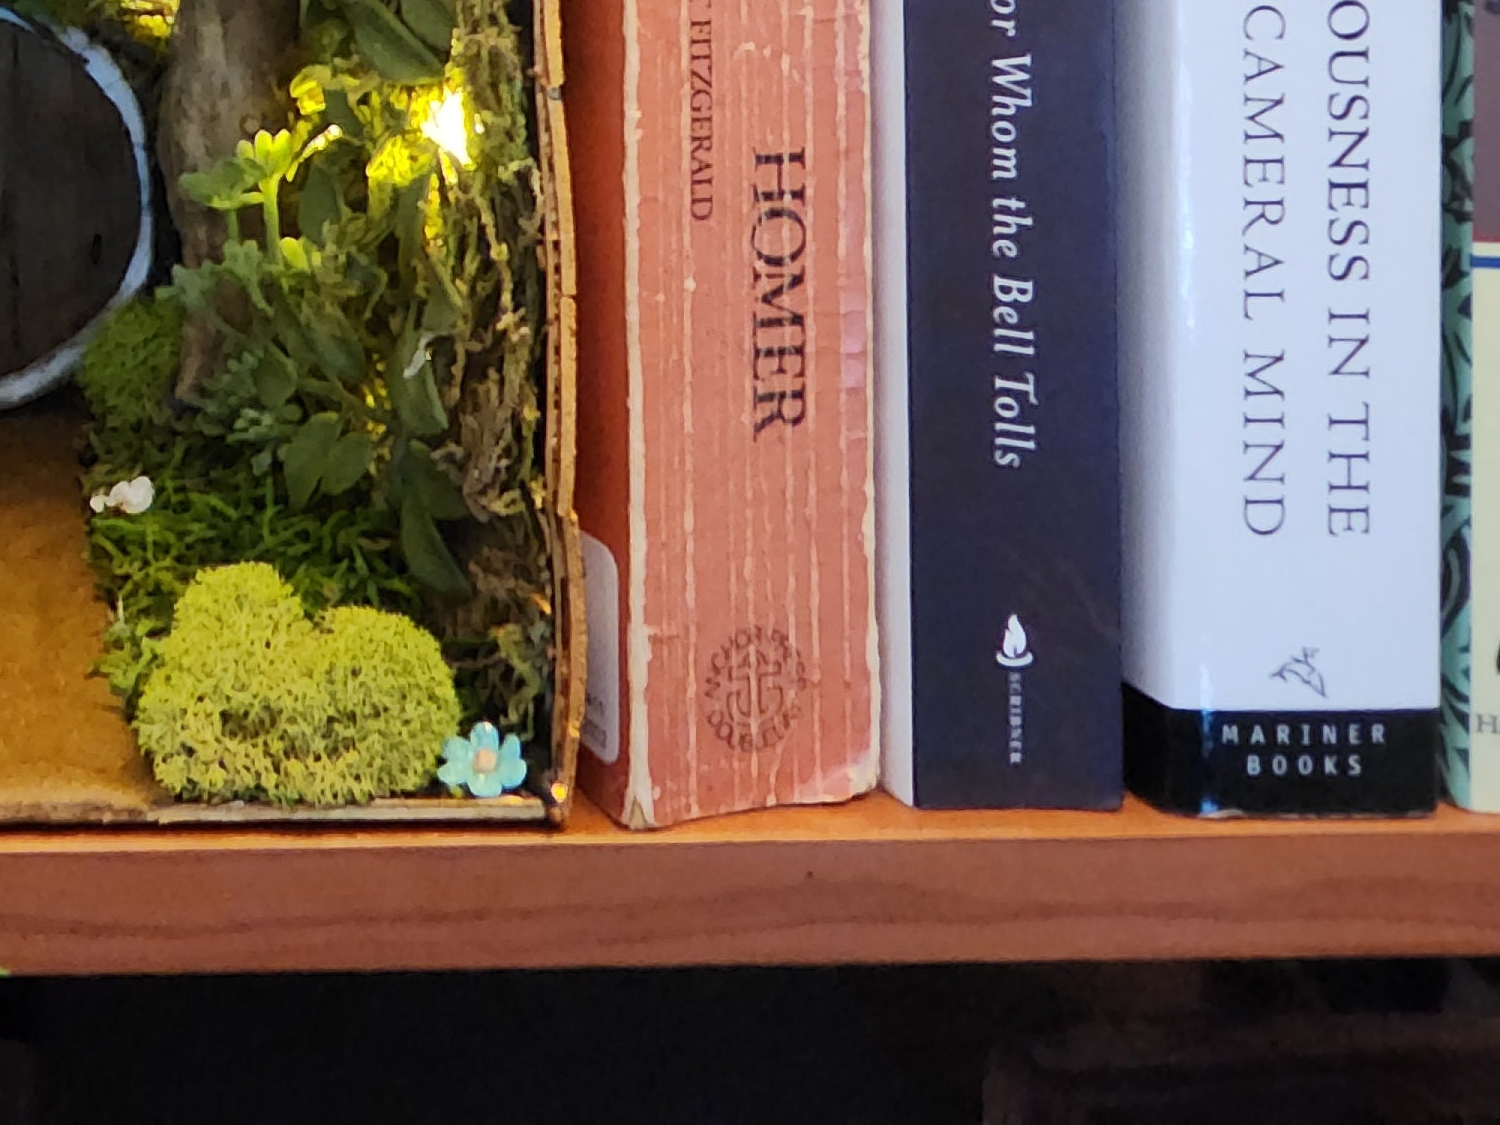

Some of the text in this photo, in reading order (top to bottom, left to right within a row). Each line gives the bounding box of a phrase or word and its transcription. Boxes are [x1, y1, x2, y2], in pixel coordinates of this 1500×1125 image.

[690, 20, 713, 222] FITZGERALD
[991, 53, 1033, 179] Whom
[992, 196, 1034, 258] the
[751, 146, 806, 443] HOMER
[993, 275, 1036, 356] Bell
[1328, 308, 1370, 379] IN
[994, 372, 1038, 468] Tolls
[1244, 349, 1285, 536] MIND
[1327, 403, 1370, 537] THE
[1222, 723, 1386, 745] MARINER
[1246, 755, 1362, 776] BOOKS
